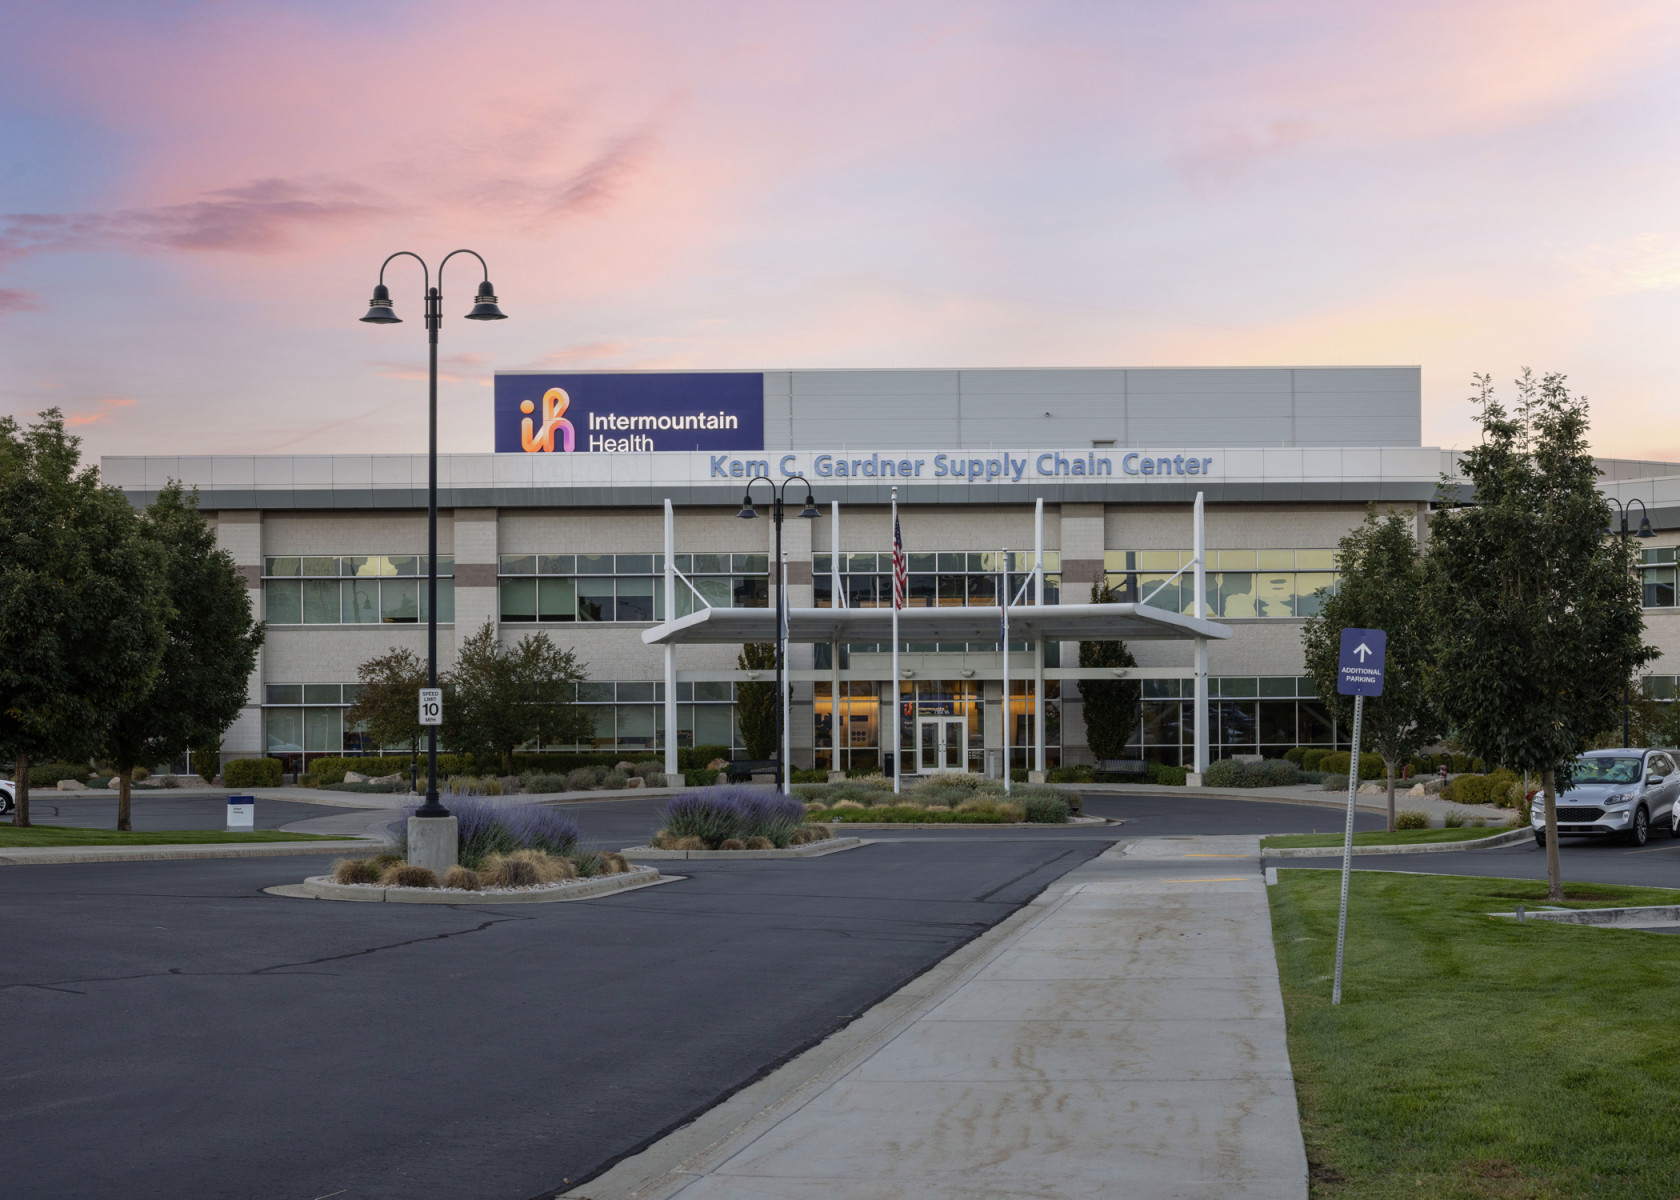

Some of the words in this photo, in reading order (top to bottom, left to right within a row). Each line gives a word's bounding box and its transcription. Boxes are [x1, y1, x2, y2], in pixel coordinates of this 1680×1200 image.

[589, 411, 738, 430] Intermountain
[589, 434, 654, 452] Health
[710, 455, 769, 477] Kem
[779, 455, 804, 477] C.
[813, 453, 925, 477] Gardner
[934, 452, 1027, 481] Supply
[1036, 452, 1112, 475] Chain
[1122, 453, 1213, 475] Center
[1341, 667, 1381, 675] ADDITIONAL
[422, 703, 439, 716] 10
